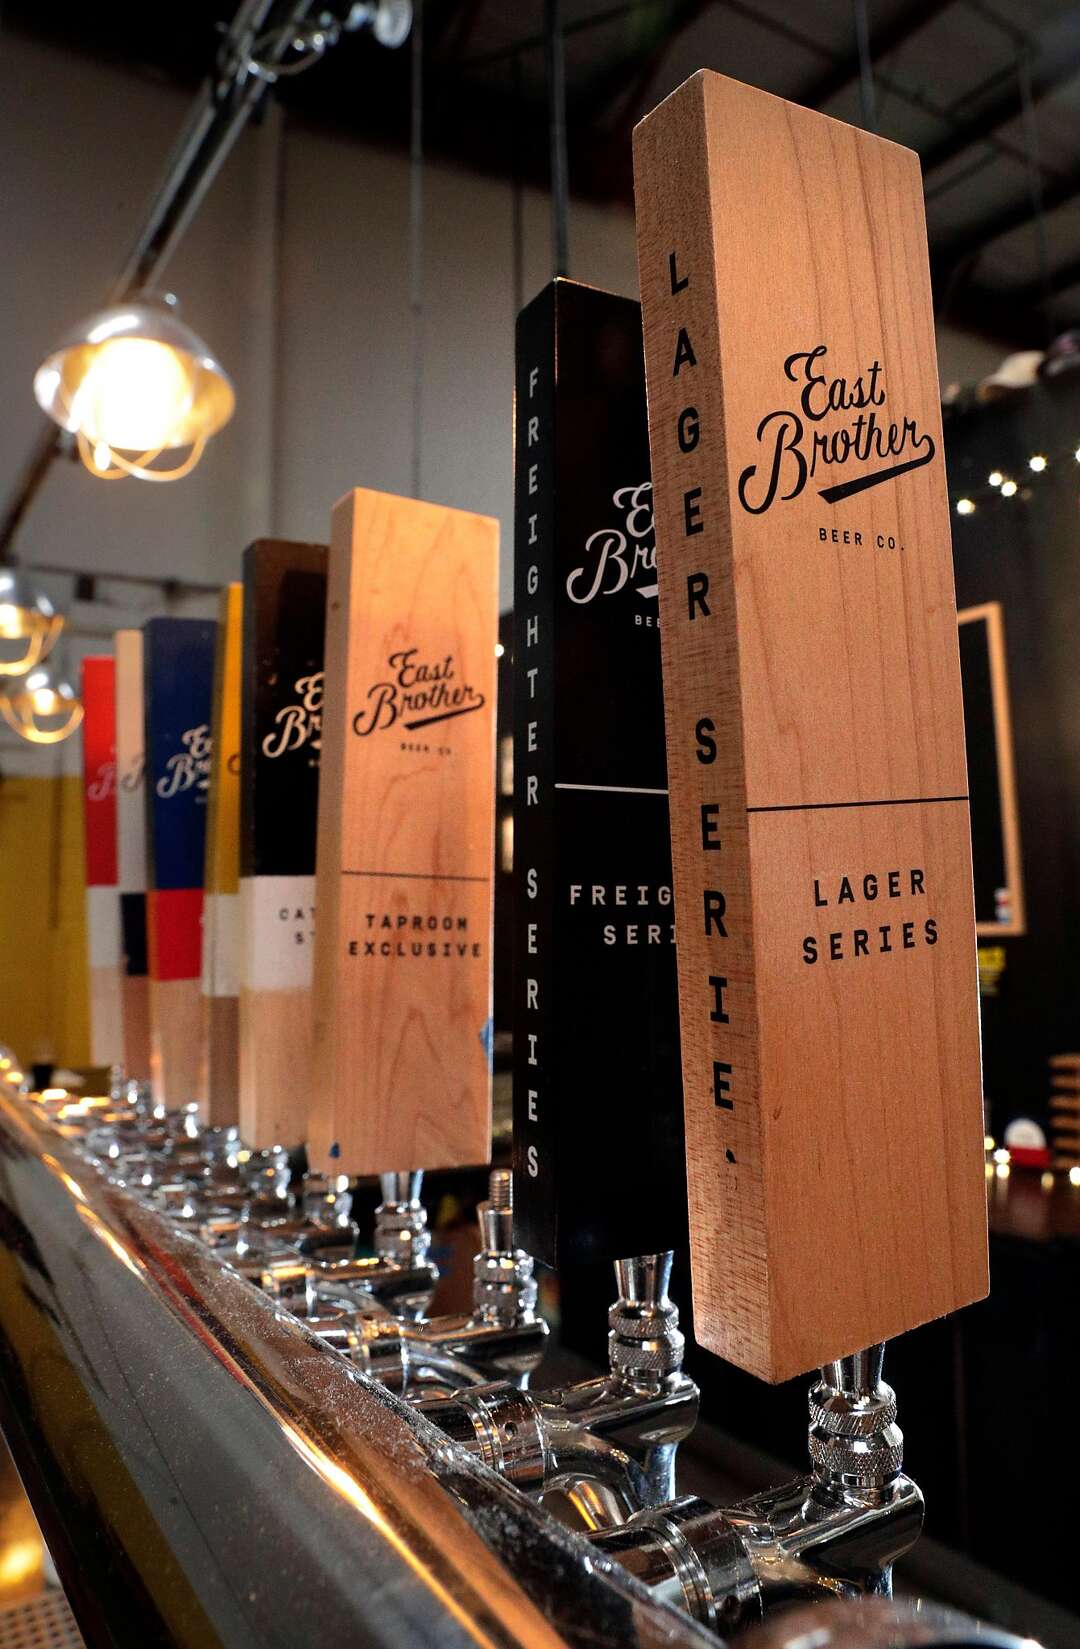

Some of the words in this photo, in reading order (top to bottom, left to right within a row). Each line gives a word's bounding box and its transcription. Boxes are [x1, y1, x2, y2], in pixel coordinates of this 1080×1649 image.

[784, 345, 886, 421] East
[669, 251, 711, 620] LAGER
[738, 411, 936, 515] Brother
[819, 527, 863, 546] BEER
[877, 535, 904, 551] CO.
[526, 366, 539, 806] FREIGHTER
[388, 648, 454, 688] East
[352, 682, 485, 737] Brother
[814, 869, 925, 907] LAGER
[365, 914, 468, 931] TAPROOM
[802, 918, 938, 965] SERIES
[348, 941, 480, 957] EXCLUSIVE
[526, 867, 539, 1178] SERIES
